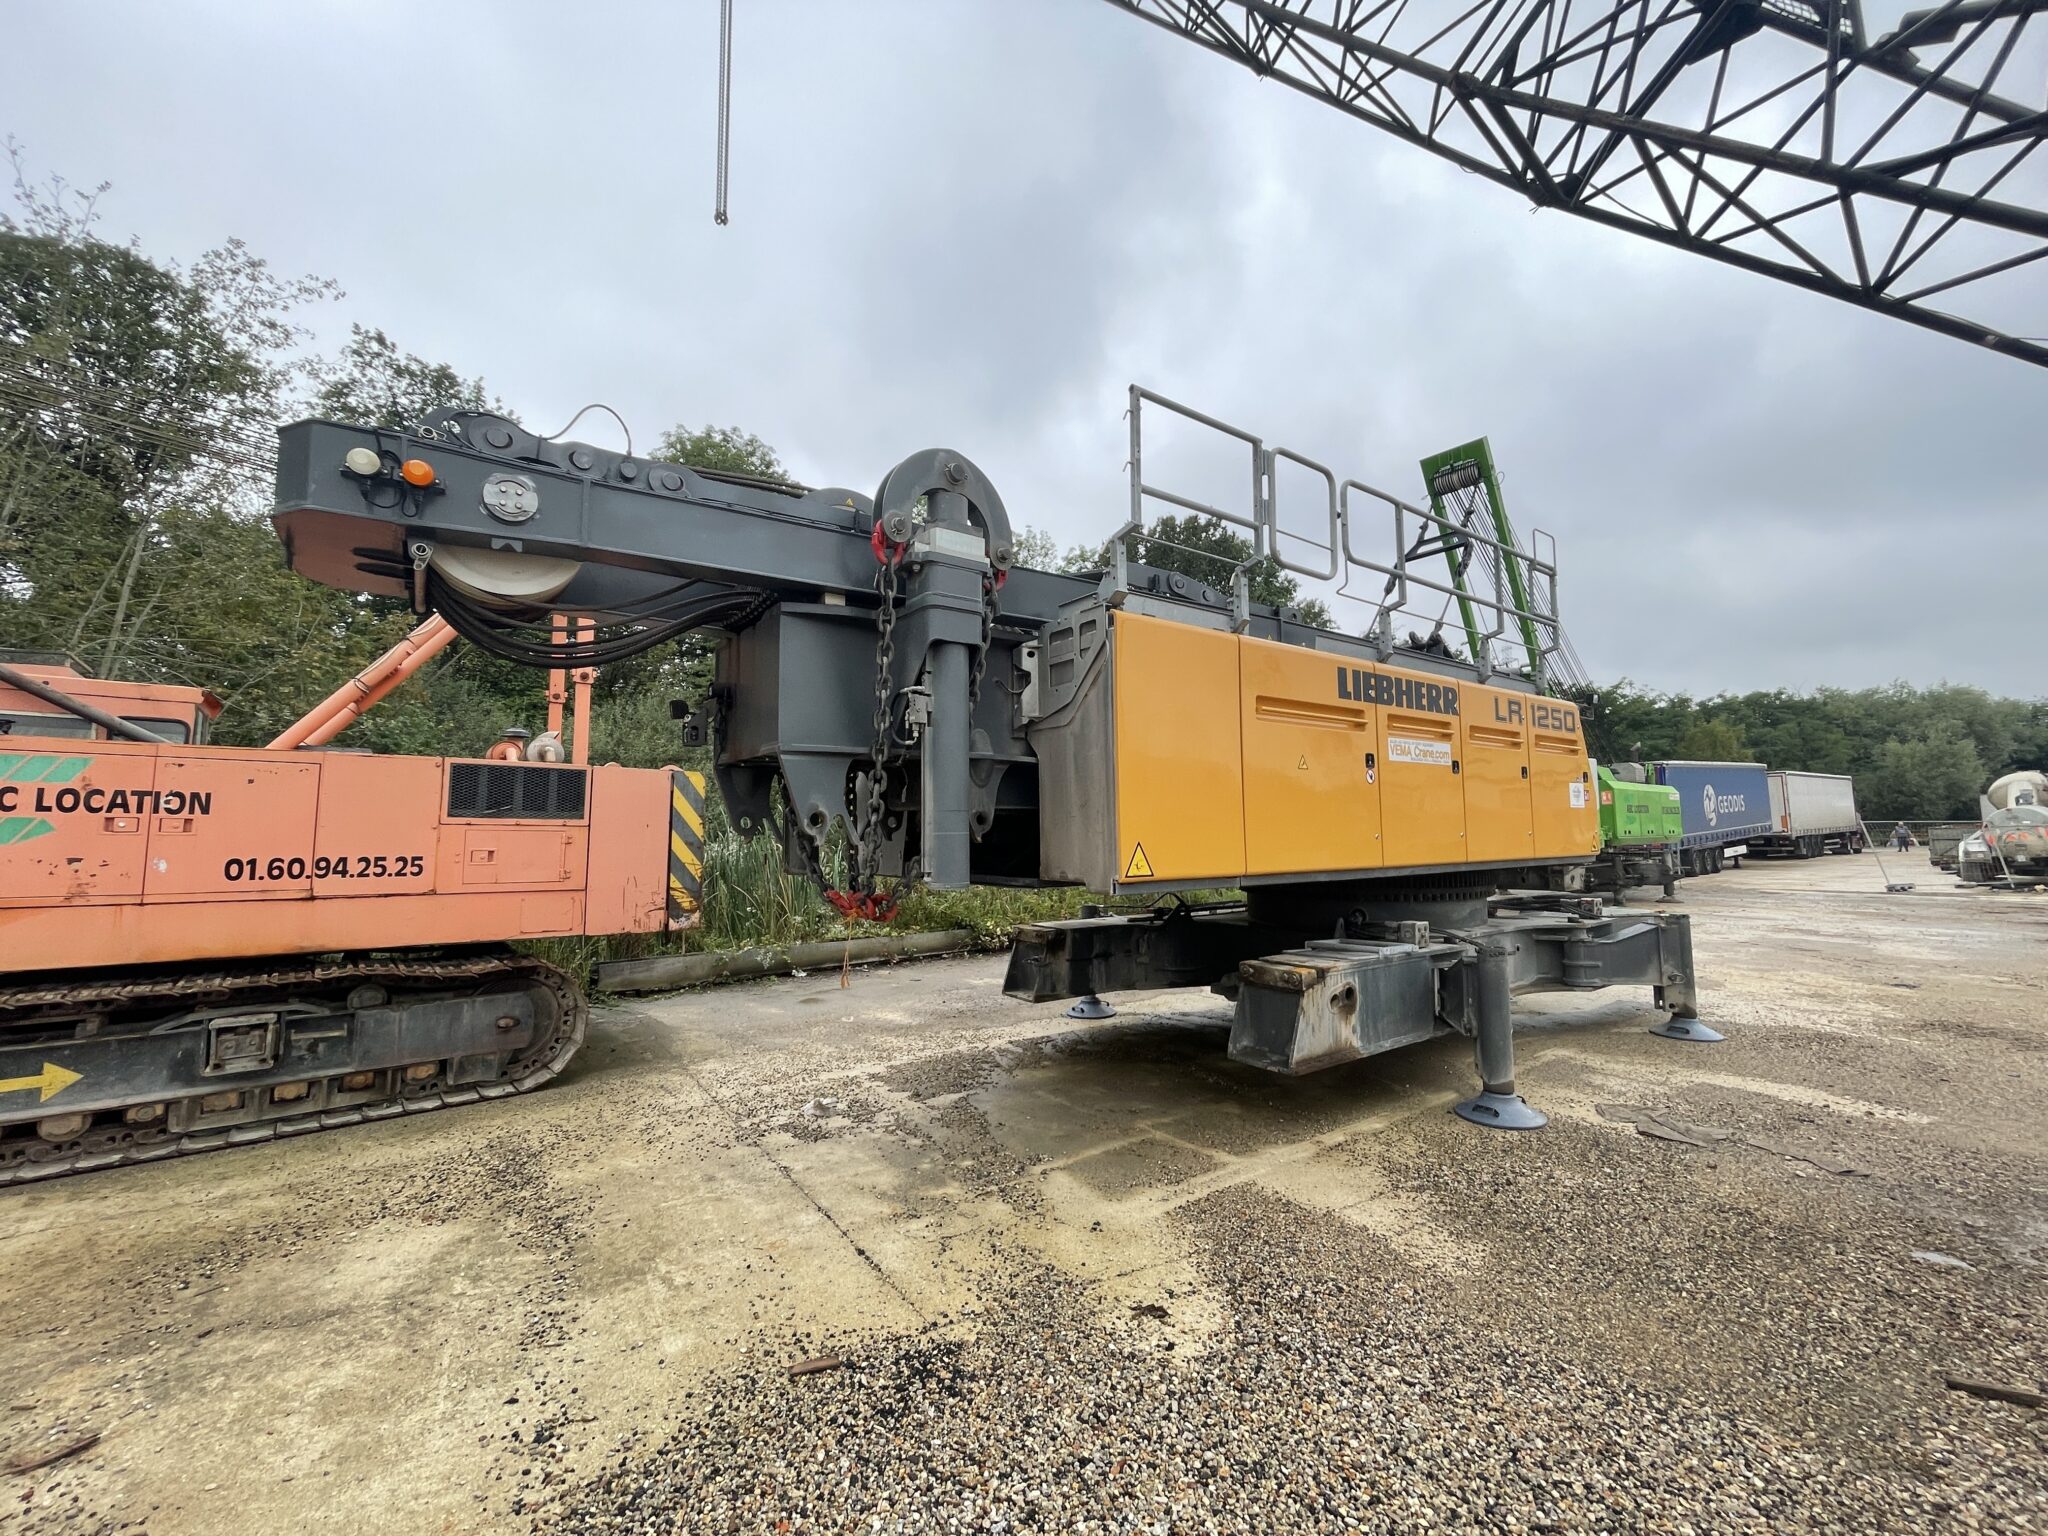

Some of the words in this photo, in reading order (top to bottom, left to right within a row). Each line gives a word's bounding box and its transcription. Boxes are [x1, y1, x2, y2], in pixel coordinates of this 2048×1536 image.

[1337, 667, 1460, 716] LIEBHERR
[1494, 696, 1523, 725] LR
[1530, 702, 1576, 733] 1250
[35, 787, 212, 815] LOCATION
[1717, 794, 1746, 814] GEODIS
[224, 856, 424, 882] 01.60.94.25.25
